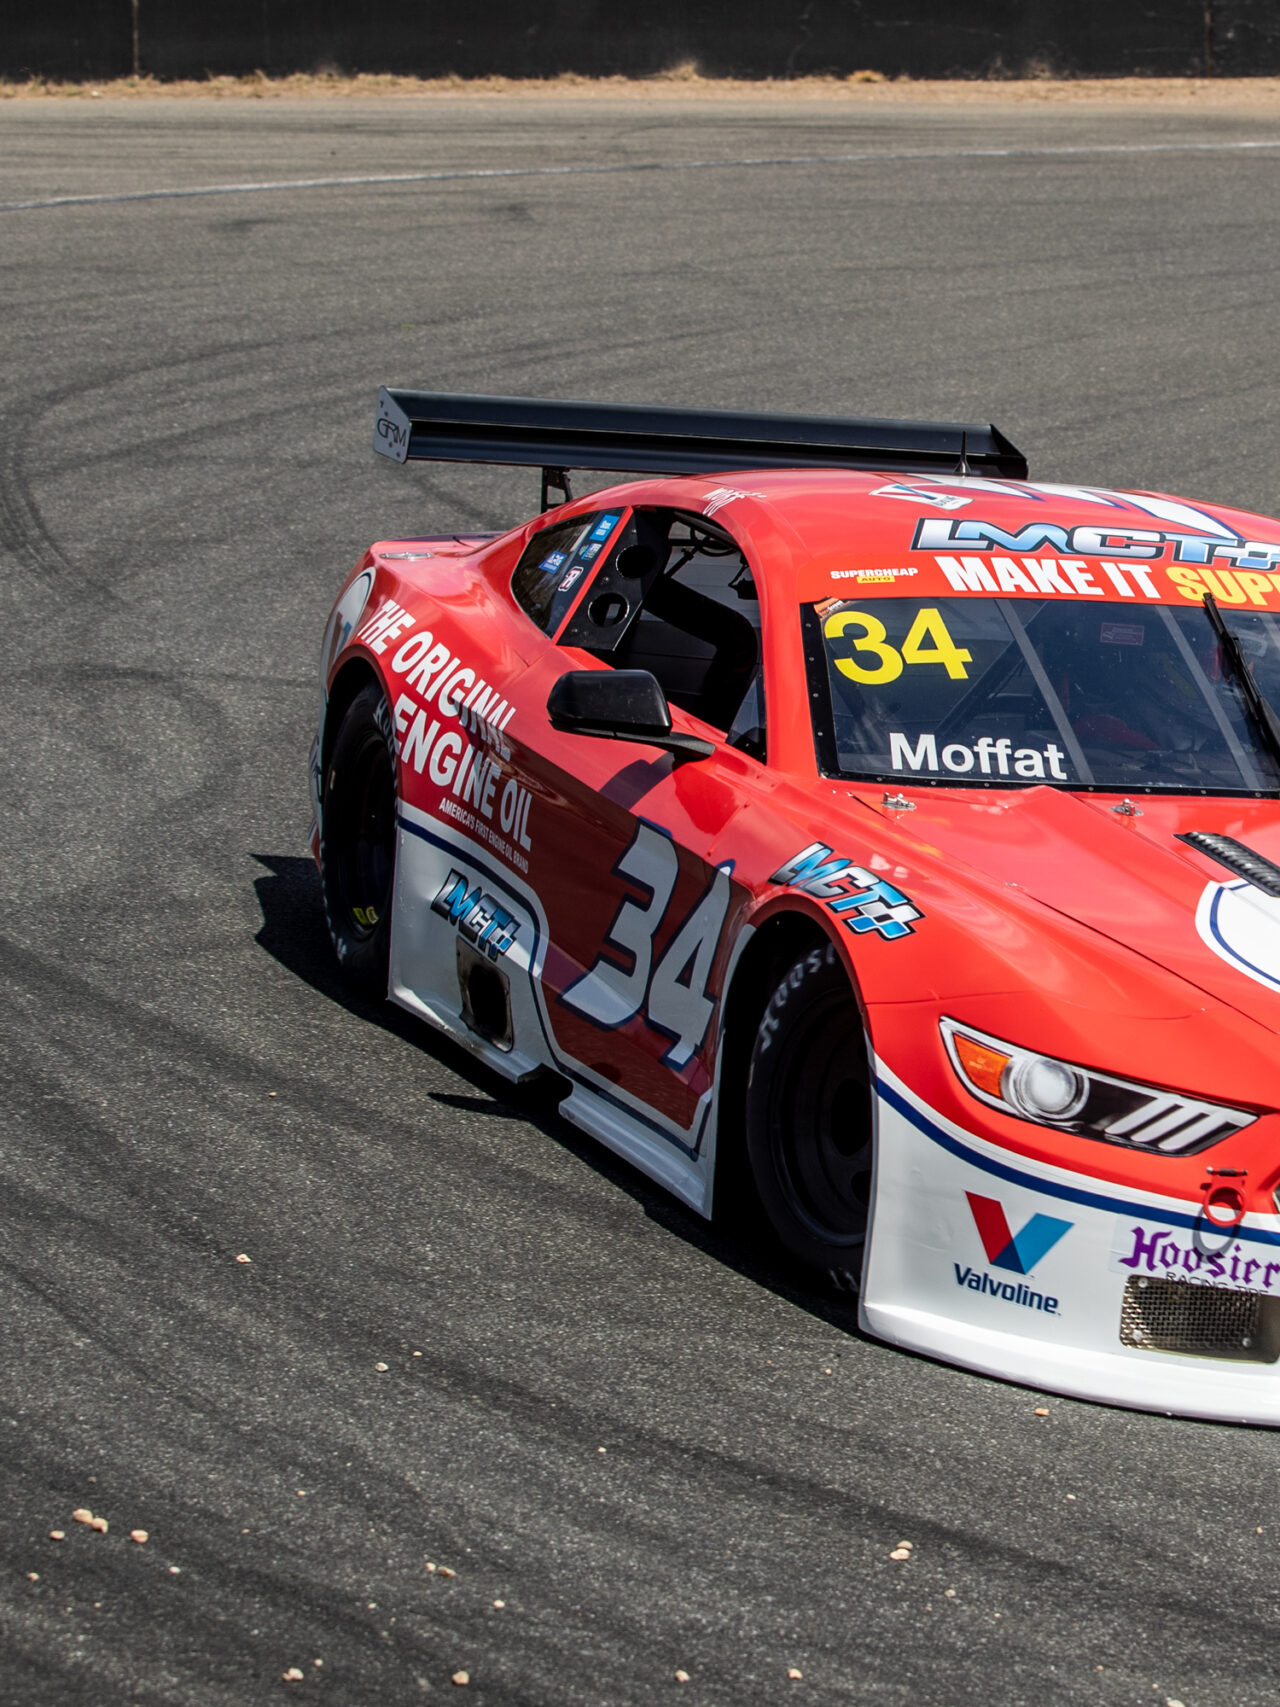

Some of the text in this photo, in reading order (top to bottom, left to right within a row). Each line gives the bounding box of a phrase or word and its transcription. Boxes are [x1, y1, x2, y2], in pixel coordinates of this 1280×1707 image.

[830, 567, 918, 579] SUPERCHEAP
[934, 556, 1105, 596] MAKE
[1099, 561, 1162, 599] IT
[824, 607, 973, 685] 34
[357, 599, 517, 761] THE ORIGINAL
[394, 693, 502, 820] ENGINE
[500, 779, 533, 852] OIL
[890, 732, 1068, 781] Moffat
[557, 817, 736, 1072] 34
[953, 1263, 1059, 1315] Valvoline
